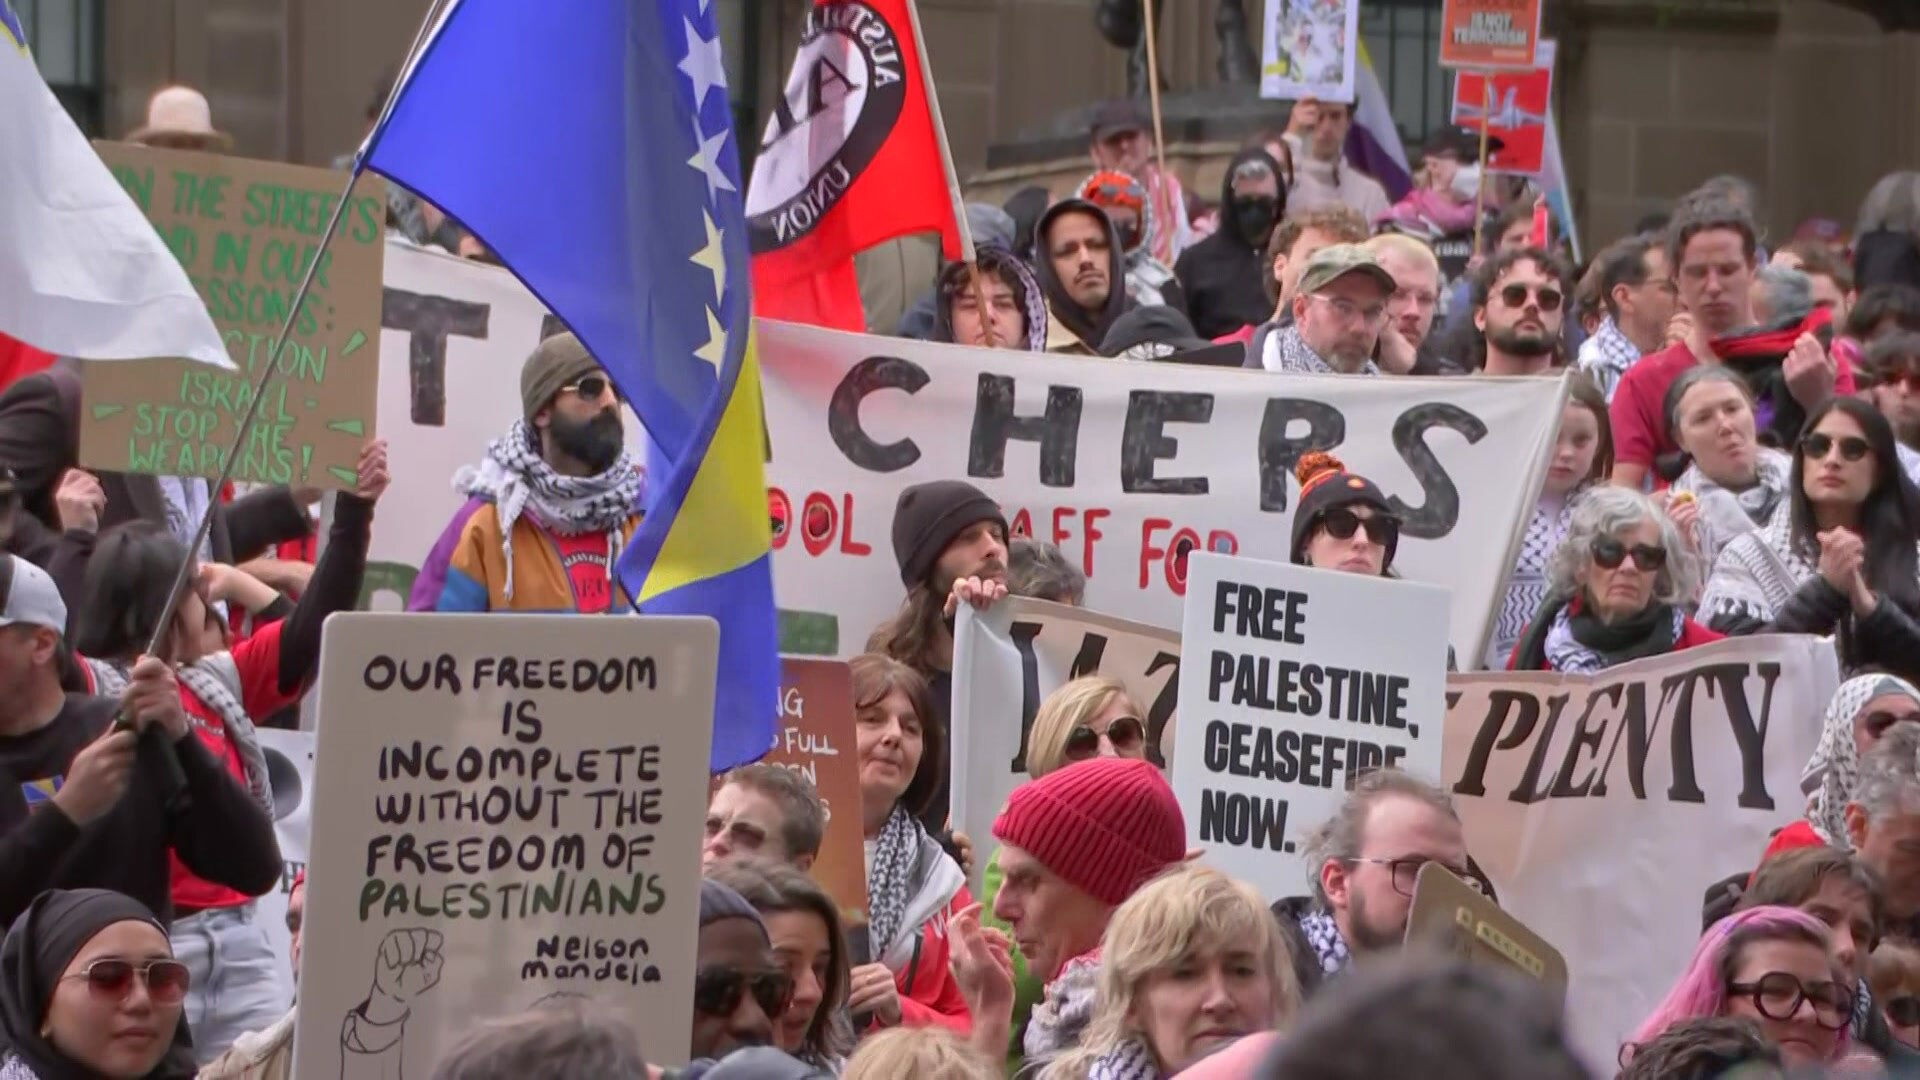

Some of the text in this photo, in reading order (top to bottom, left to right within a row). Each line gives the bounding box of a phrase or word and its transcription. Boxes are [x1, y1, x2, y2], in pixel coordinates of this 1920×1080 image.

[172, 171, 231, 220] THE
[243, 183, 380, 244] STREETS
[261, 239, 333, 289] OUR
[134, 402, 217, 442] STOP
[180, 370, 295, 424] ISRAEL
[381, 286, 1488, 540] TCHERS
[1213, 580, 1309, 645] FREE
[364, 654, 657, 694] OUR FREEDOM
[1208, 649, 1419, 739] PALESTINE,
[502, 700, 542, 743] IS
[784, 726, 839, 755] FULL
[1453, 662, 1781, 810] PLENTY
[379, 741, 660, 783] INCOMPLETE
[376, 786, 662, 828] WITHOUT THE
[1199, 788, 1296, 854] NOW.
[366, 835, 655, 877] FREEDOM OF
[360, 870, 665, 922] PALESTINIANS
[536, 934, 649, 962] Nelson
